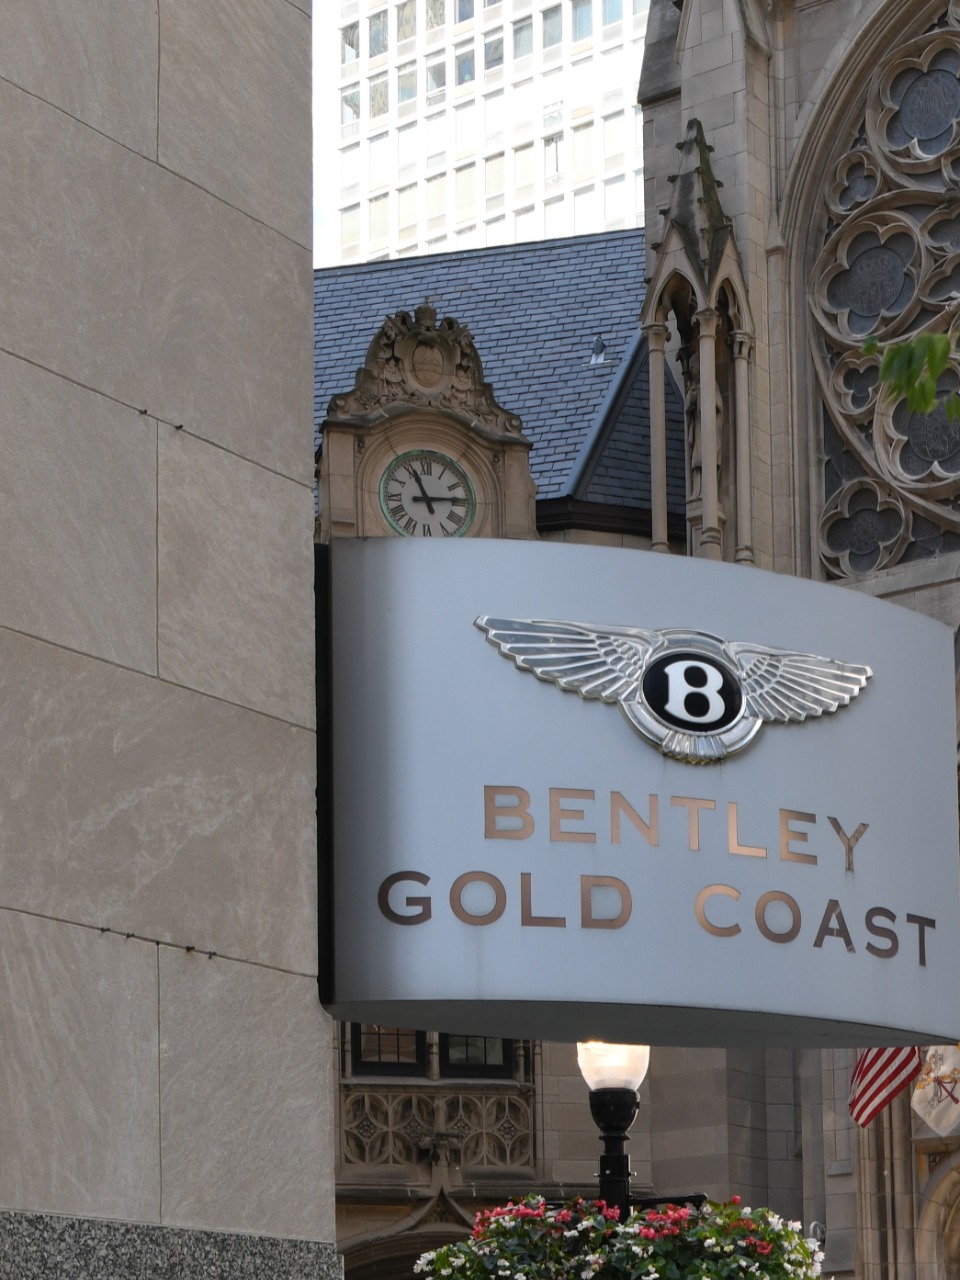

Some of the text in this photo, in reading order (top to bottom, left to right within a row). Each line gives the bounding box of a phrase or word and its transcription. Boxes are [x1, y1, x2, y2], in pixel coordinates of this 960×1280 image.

[664, 658, 726, 724] B
[483, 785, 870, 872] BENTLEY
[377, 870, 936, 966] GOLD COAST
